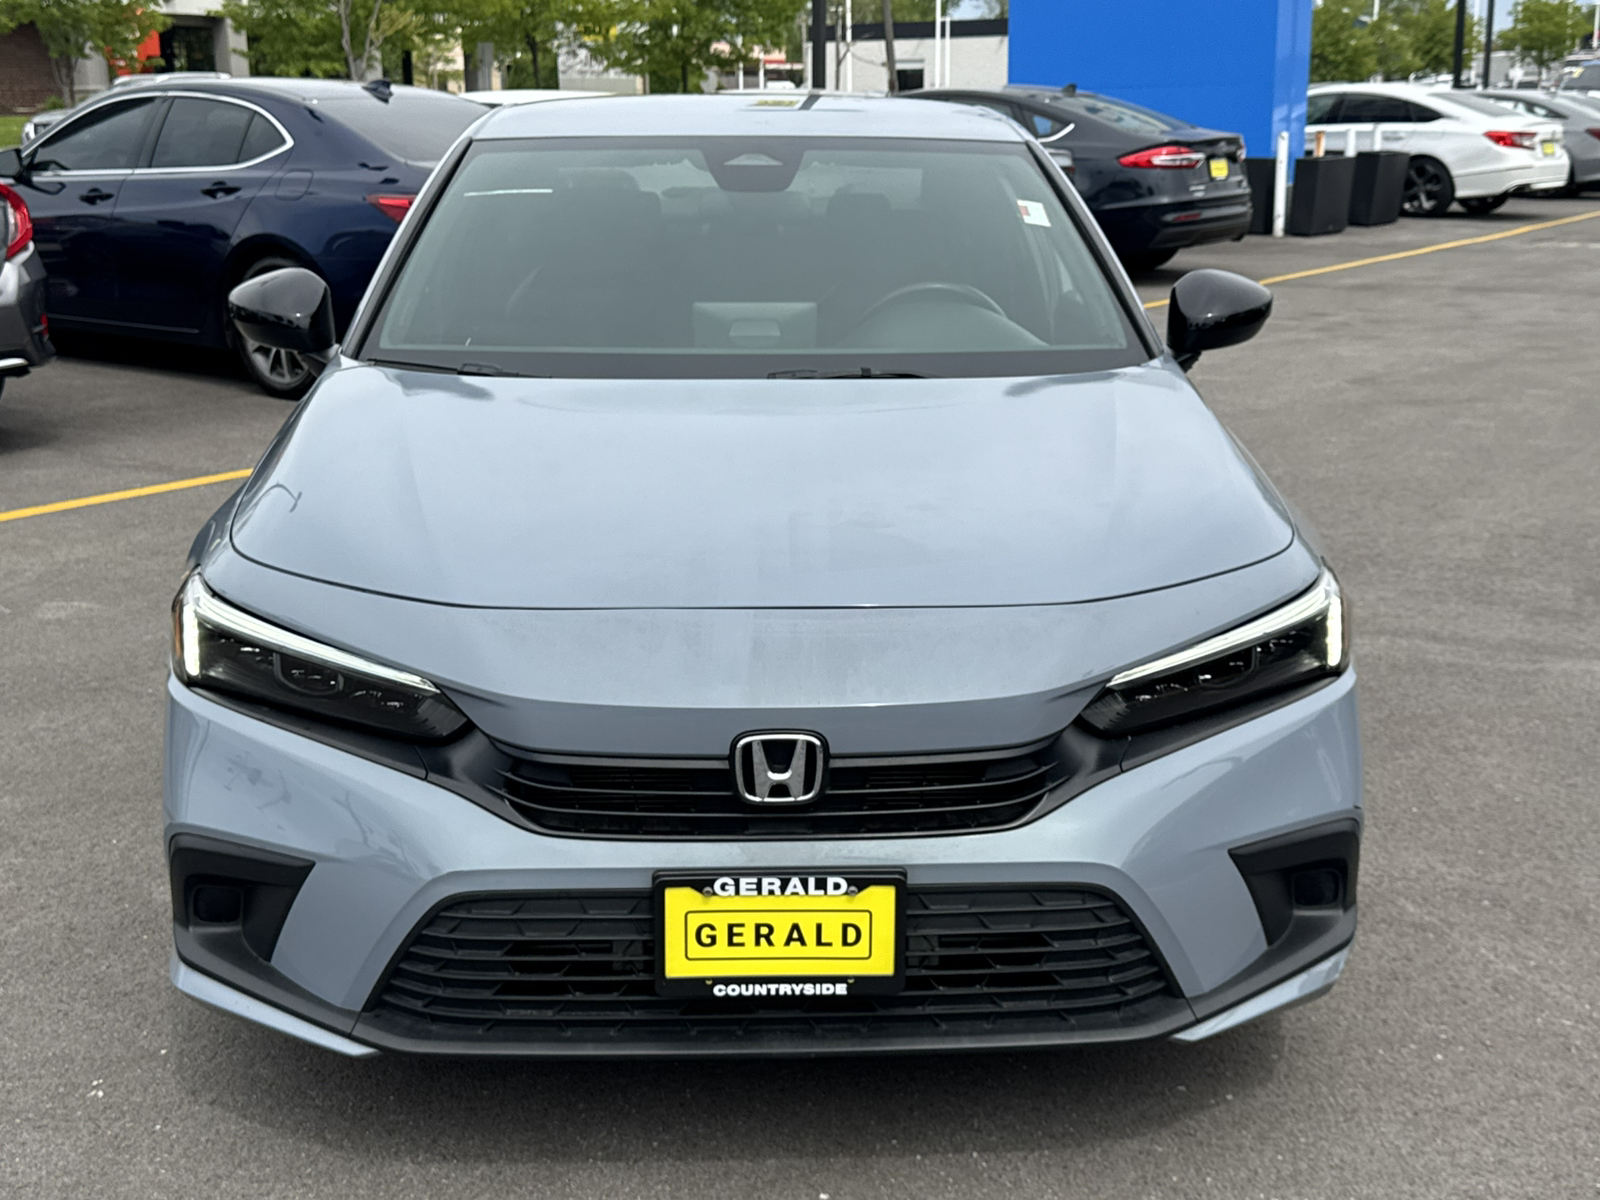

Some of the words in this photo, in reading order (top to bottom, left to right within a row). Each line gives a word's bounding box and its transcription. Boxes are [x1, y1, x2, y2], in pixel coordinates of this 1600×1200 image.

[713, 876, 848, 897] GERALD
[694, 922, 863, 948] GERALD
[713, 982, 848, 997] COUNTRYSIDE
